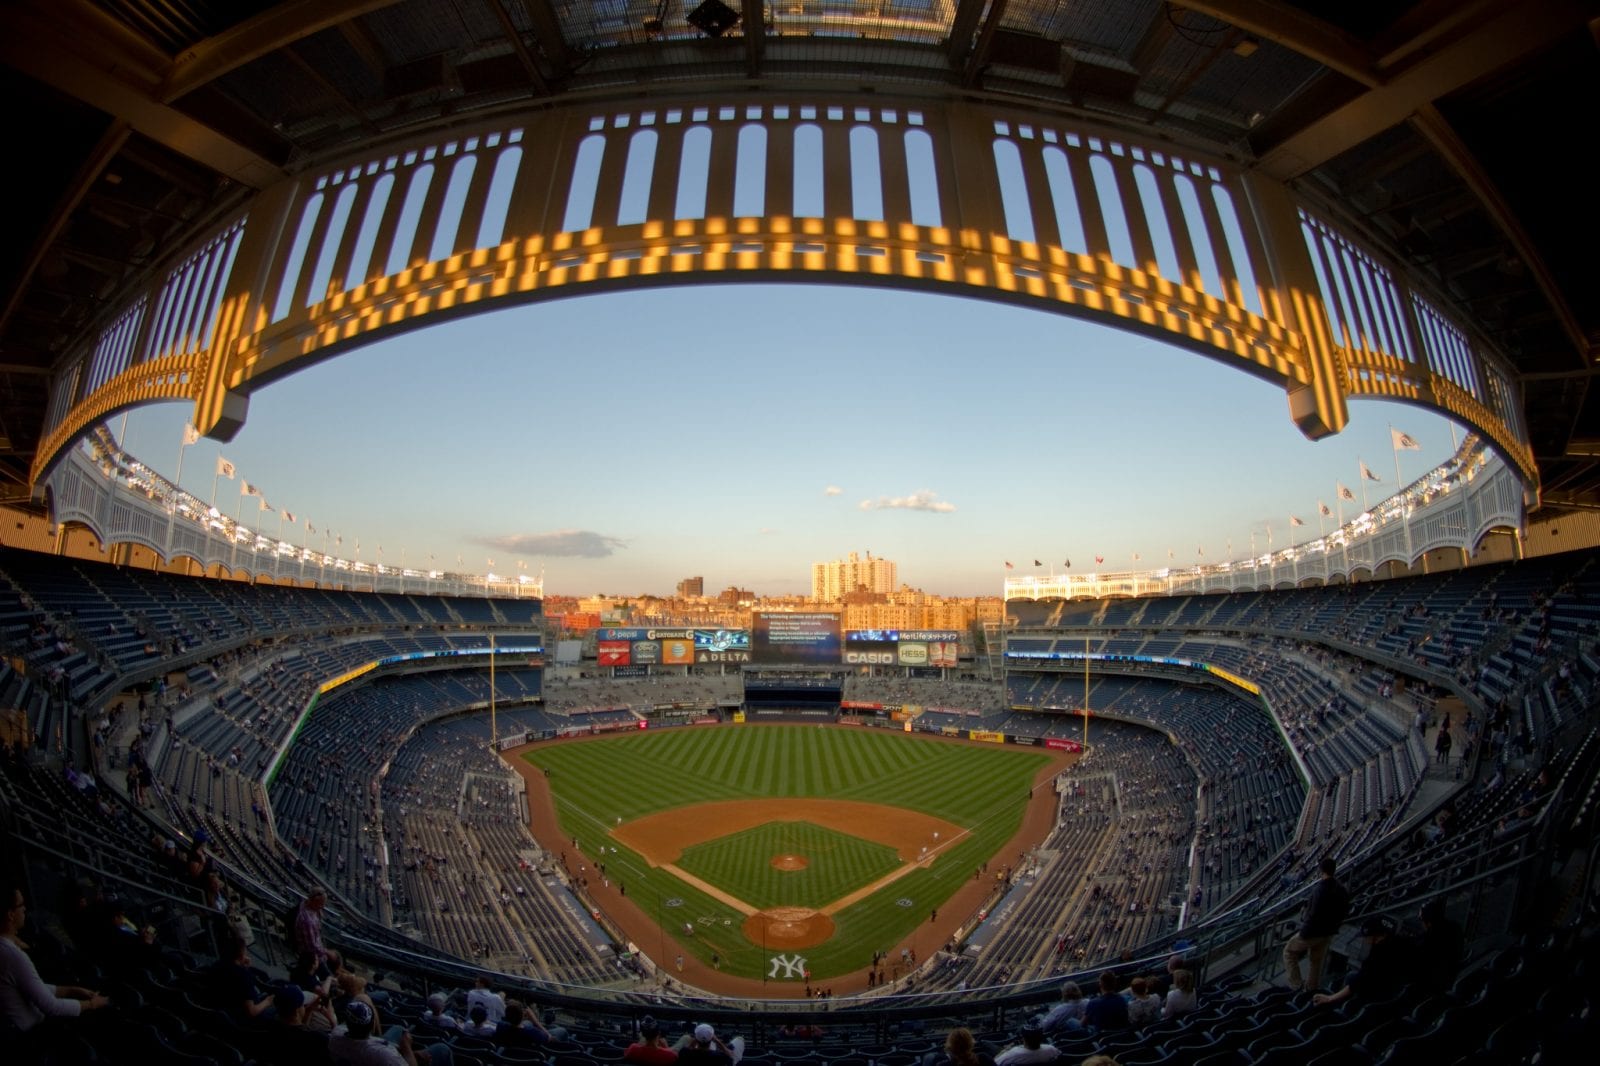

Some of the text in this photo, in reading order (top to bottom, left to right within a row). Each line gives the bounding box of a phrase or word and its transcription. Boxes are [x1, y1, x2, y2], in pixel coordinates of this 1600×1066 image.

[617, 631, 637, 640] pepsi
[899, 632, 926, 640] MetLife
[711, 653, 749, 662] DELTA
[847, 653, 893, 664] CASIO
